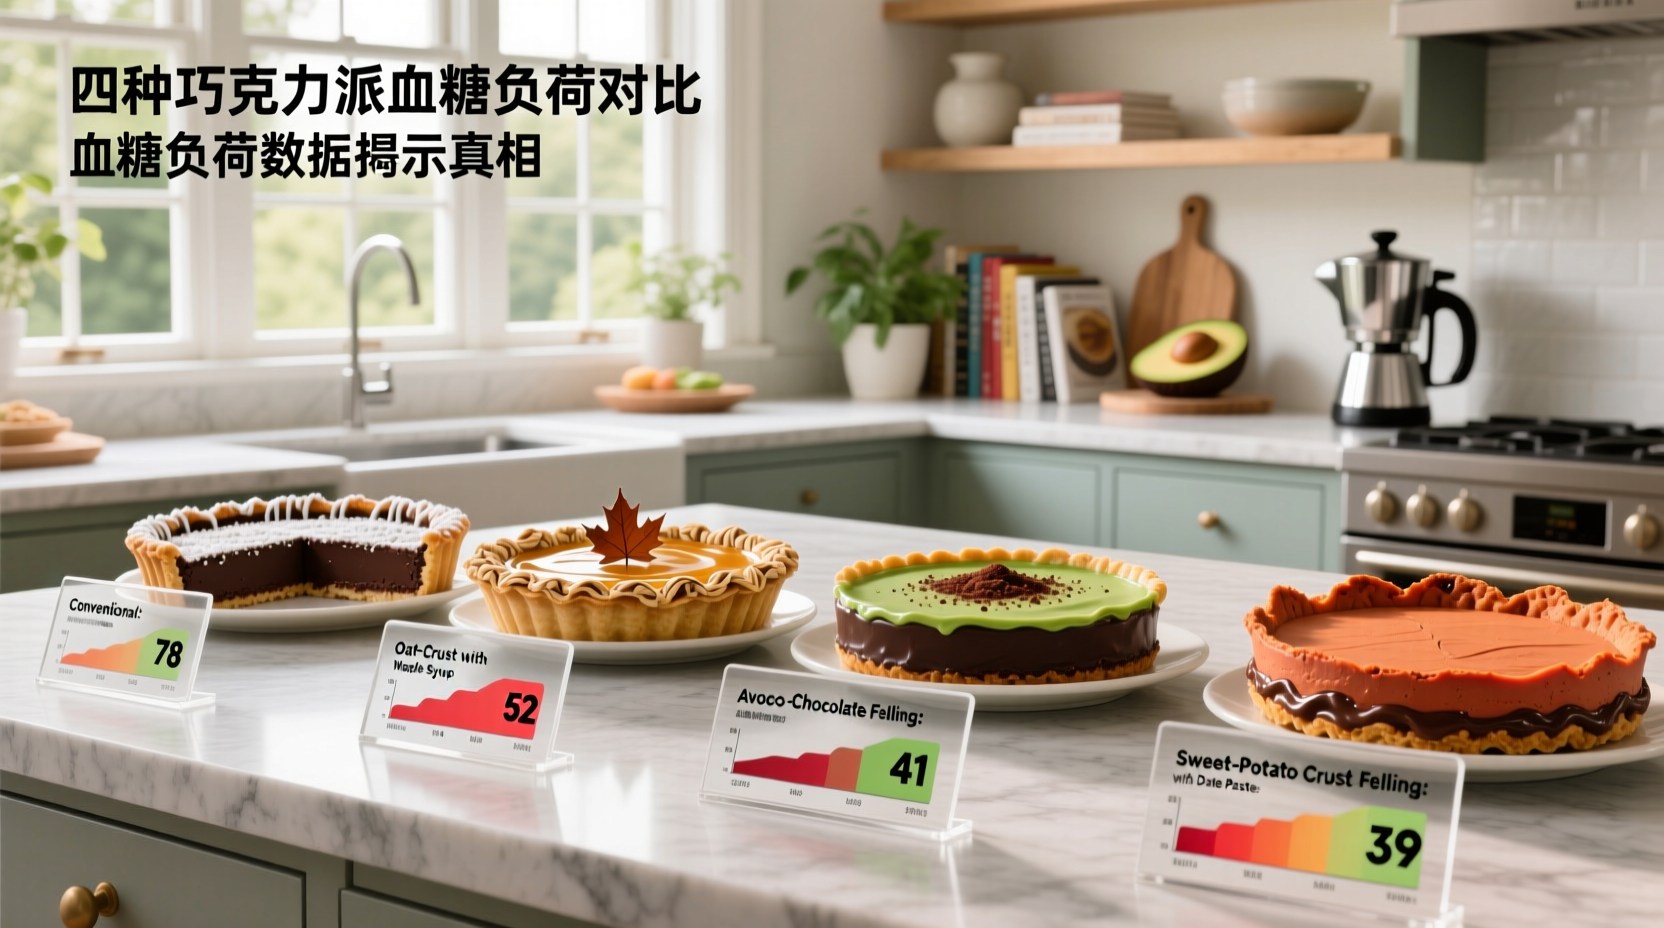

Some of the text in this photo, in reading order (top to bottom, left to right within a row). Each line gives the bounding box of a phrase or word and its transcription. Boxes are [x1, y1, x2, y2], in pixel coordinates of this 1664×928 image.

[154, 638, 184, 669] 78
[395, 641, 458, 661] Oat-Crust
[503, 692, 539, 725] 52
[869, 703, 924, 728] Felling:
[889, 752, 928, 787] 41
[1175, 749, 1429, 800] Sweet-Potato Crust Felling:
[1365, 824, 1423, 869] 39
